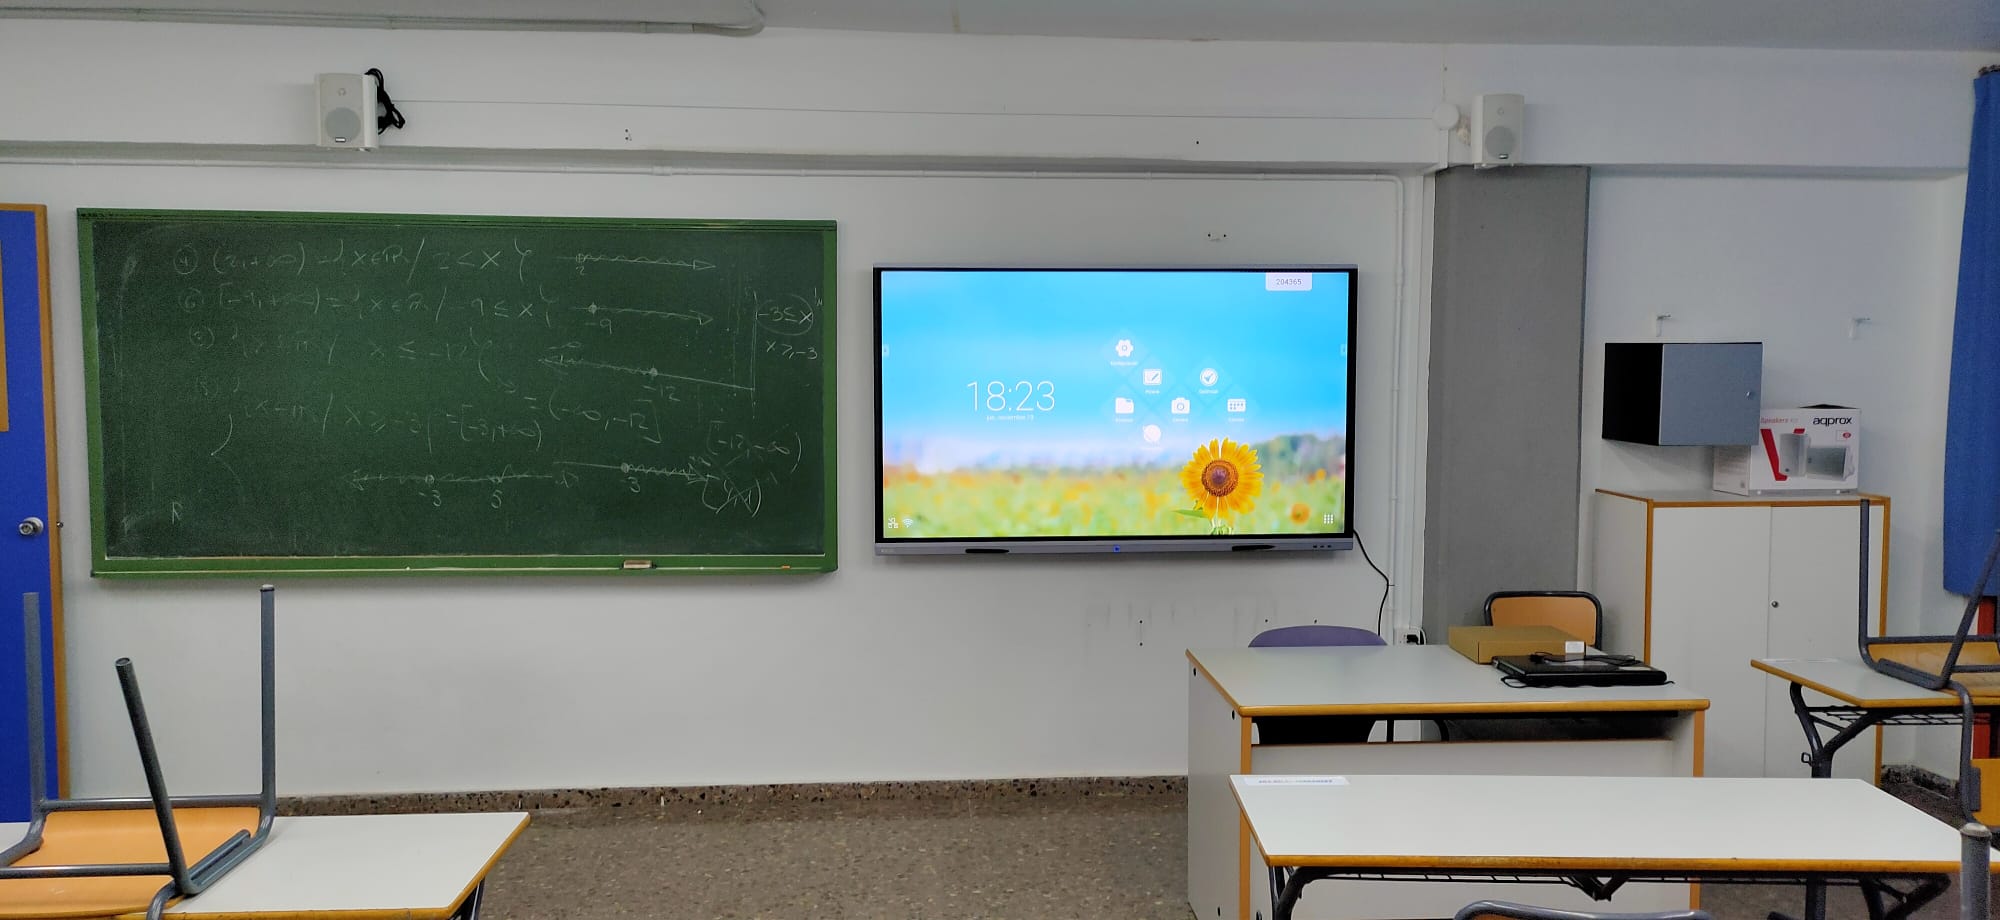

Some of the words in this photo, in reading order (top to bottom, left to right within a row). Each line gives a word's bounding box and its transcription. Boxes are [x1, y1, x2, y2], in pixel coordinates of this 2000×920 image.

[1275, 278, 1303, 286] 204365
[966, 380, 1056, 412] 18:23
[1812, 416, 1853, 427] aqprox
